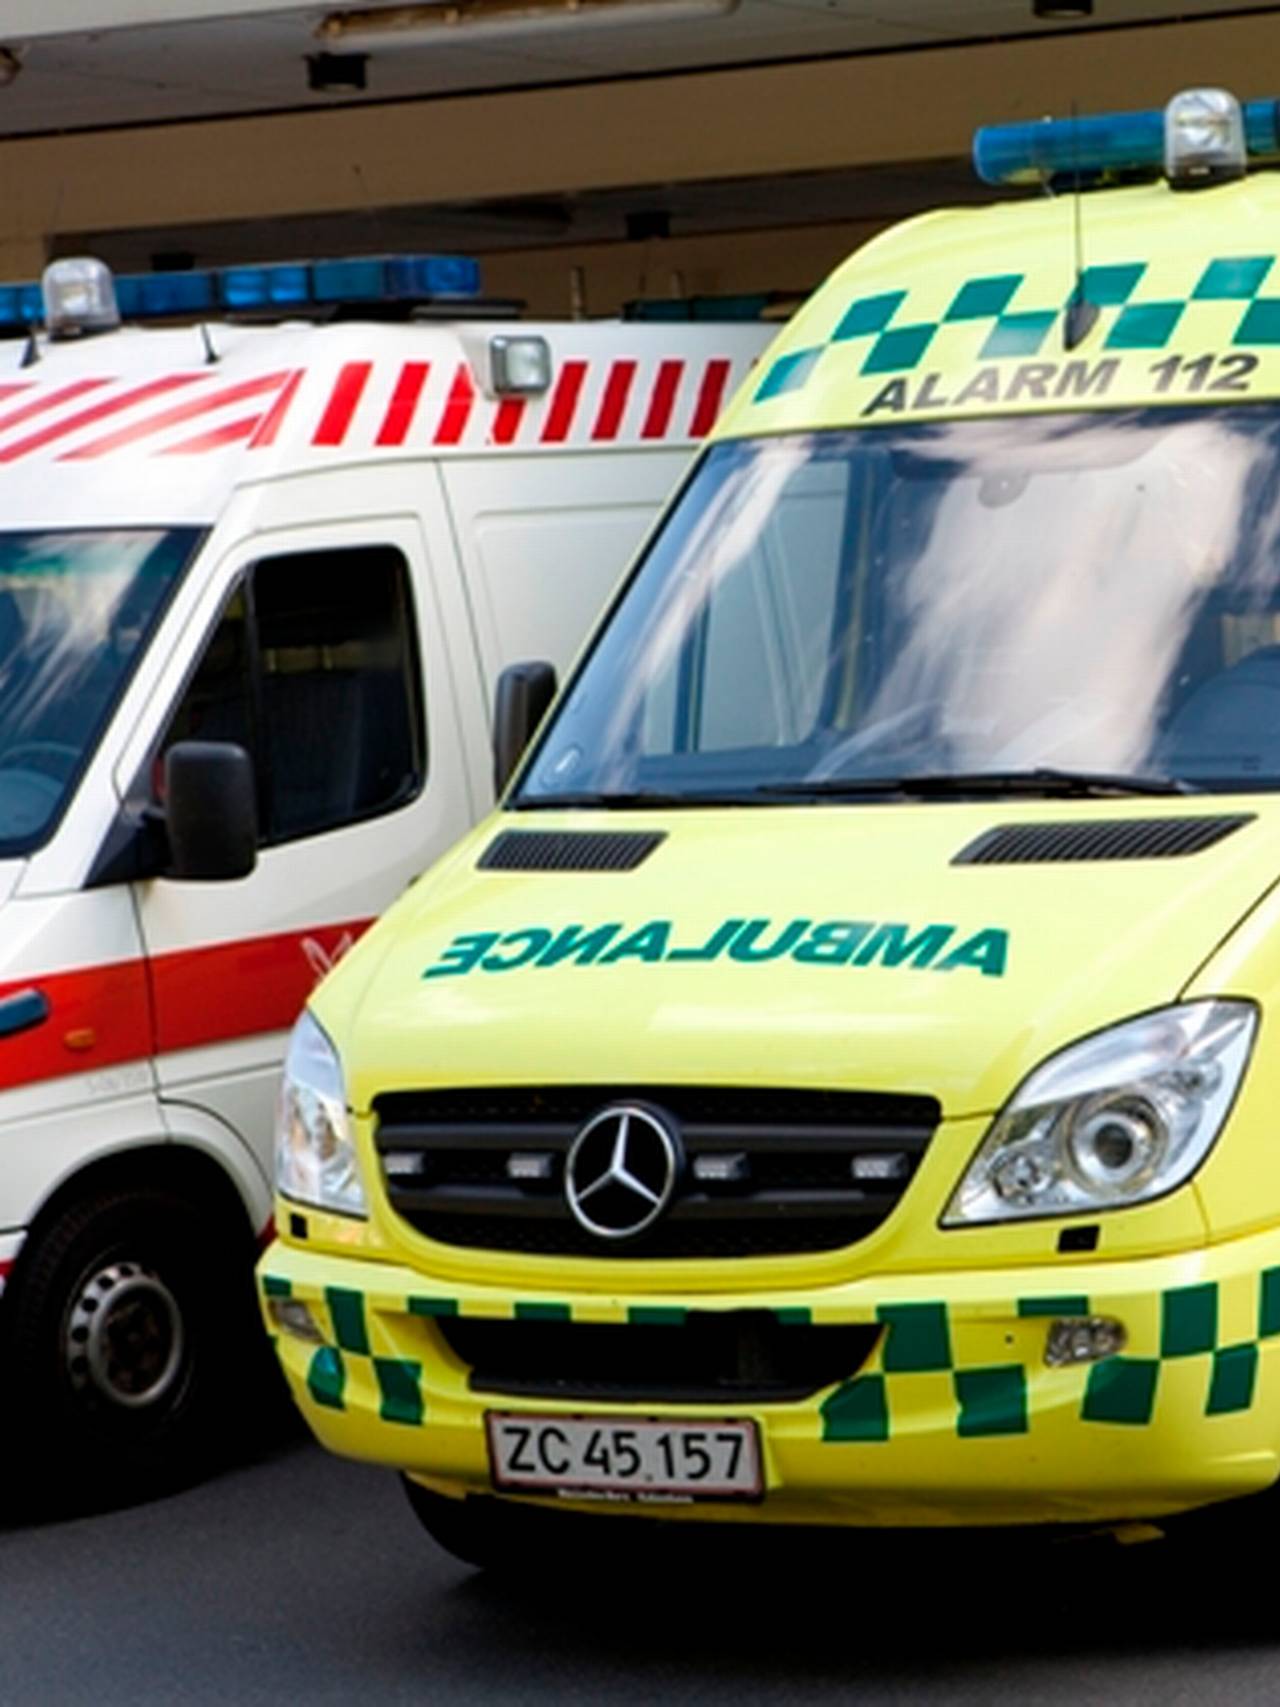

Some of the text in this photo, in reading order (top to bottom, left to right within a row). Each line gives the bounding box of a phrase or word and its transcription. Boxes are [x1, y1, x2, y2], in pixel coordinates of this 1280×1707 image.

[860, 352, 1259, 417] ALARM 112
[503, 1427, 743, 1480] ZC 45 157
